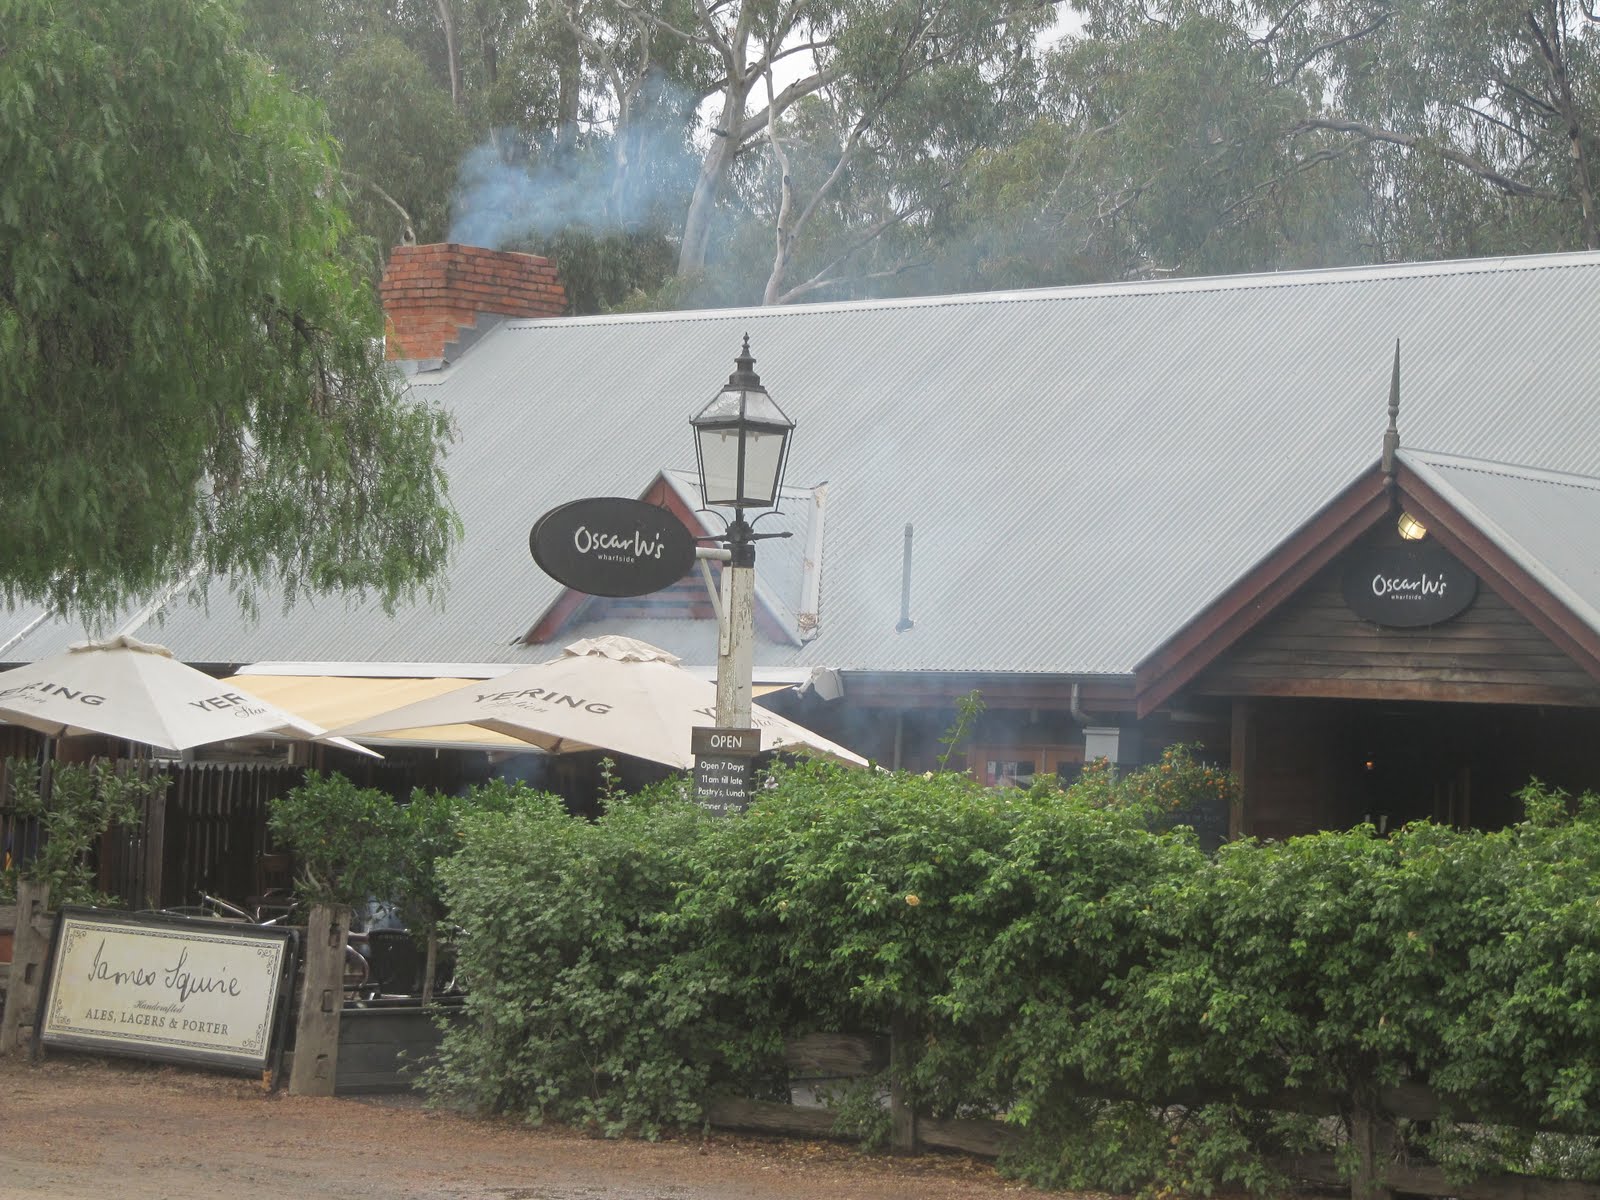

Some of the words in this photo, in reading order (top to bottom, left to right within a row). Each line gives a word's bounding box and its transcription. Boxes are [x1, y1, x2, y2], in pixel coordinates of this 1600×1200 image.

[597, 553, 635, 563] wharfside
[473, 688, 614, 714] YERING
[710, 734, 742, 748] OPEN
[700, 761, 719, 771] Open
[721, 762, 726, 770] 7
[727, 763, 744, 773] Days
[702, 775, 719, 784] 11am
[721, 776, 729, 784] till
[730, 777, 743, 785] late
[726, 789, 746, 798] Lunch
[164, 946, 241, 1003] Squire
[85, 1008, 117, 1023] ALES,
[120, 1012, 166, 1027] LAGERS
[168, 1018, 179, 1028] &
[182, 1019, 229, 1035] PORTER
